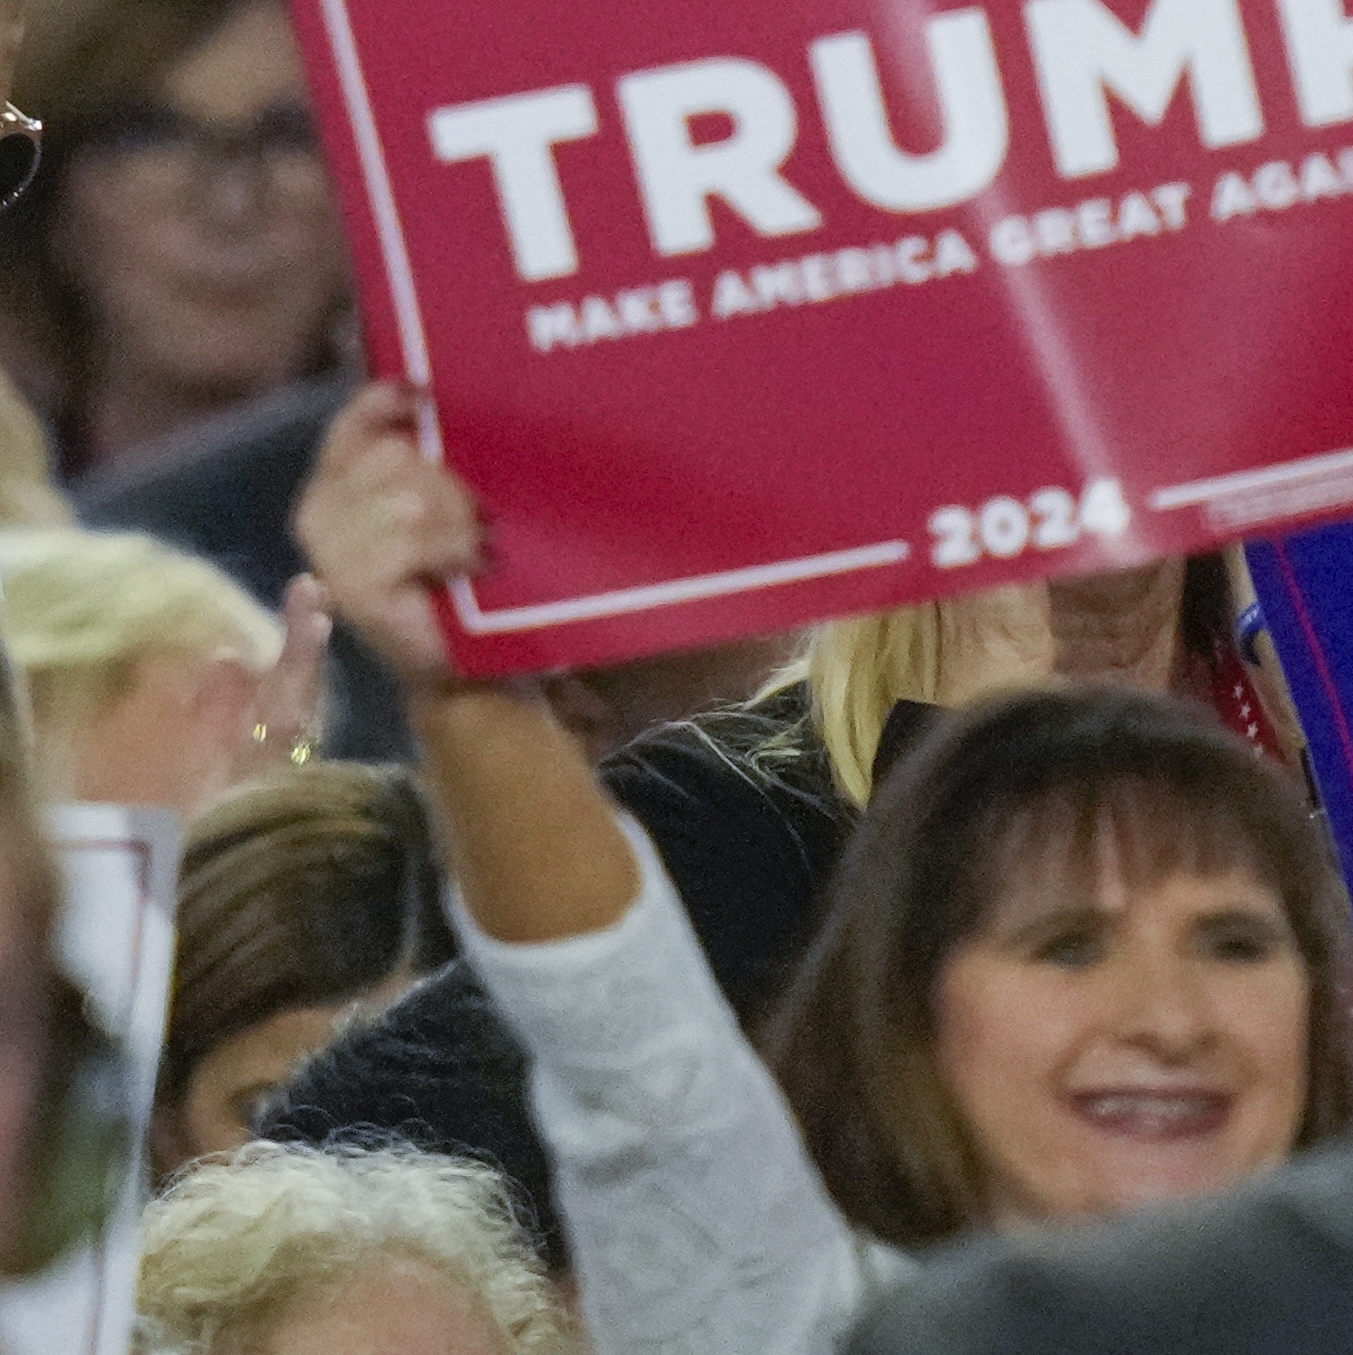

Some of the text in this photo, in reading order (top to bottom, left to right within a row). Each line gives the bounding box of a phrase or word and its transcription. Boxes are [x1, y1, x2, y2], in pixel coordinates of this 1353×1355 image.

[529, 279, 694, 349] MAKE
[712, 230, 976, 317] AMERICA
[987, 182, 1191, 266] GREAT
[929, 473, 1134, 568] 2024
